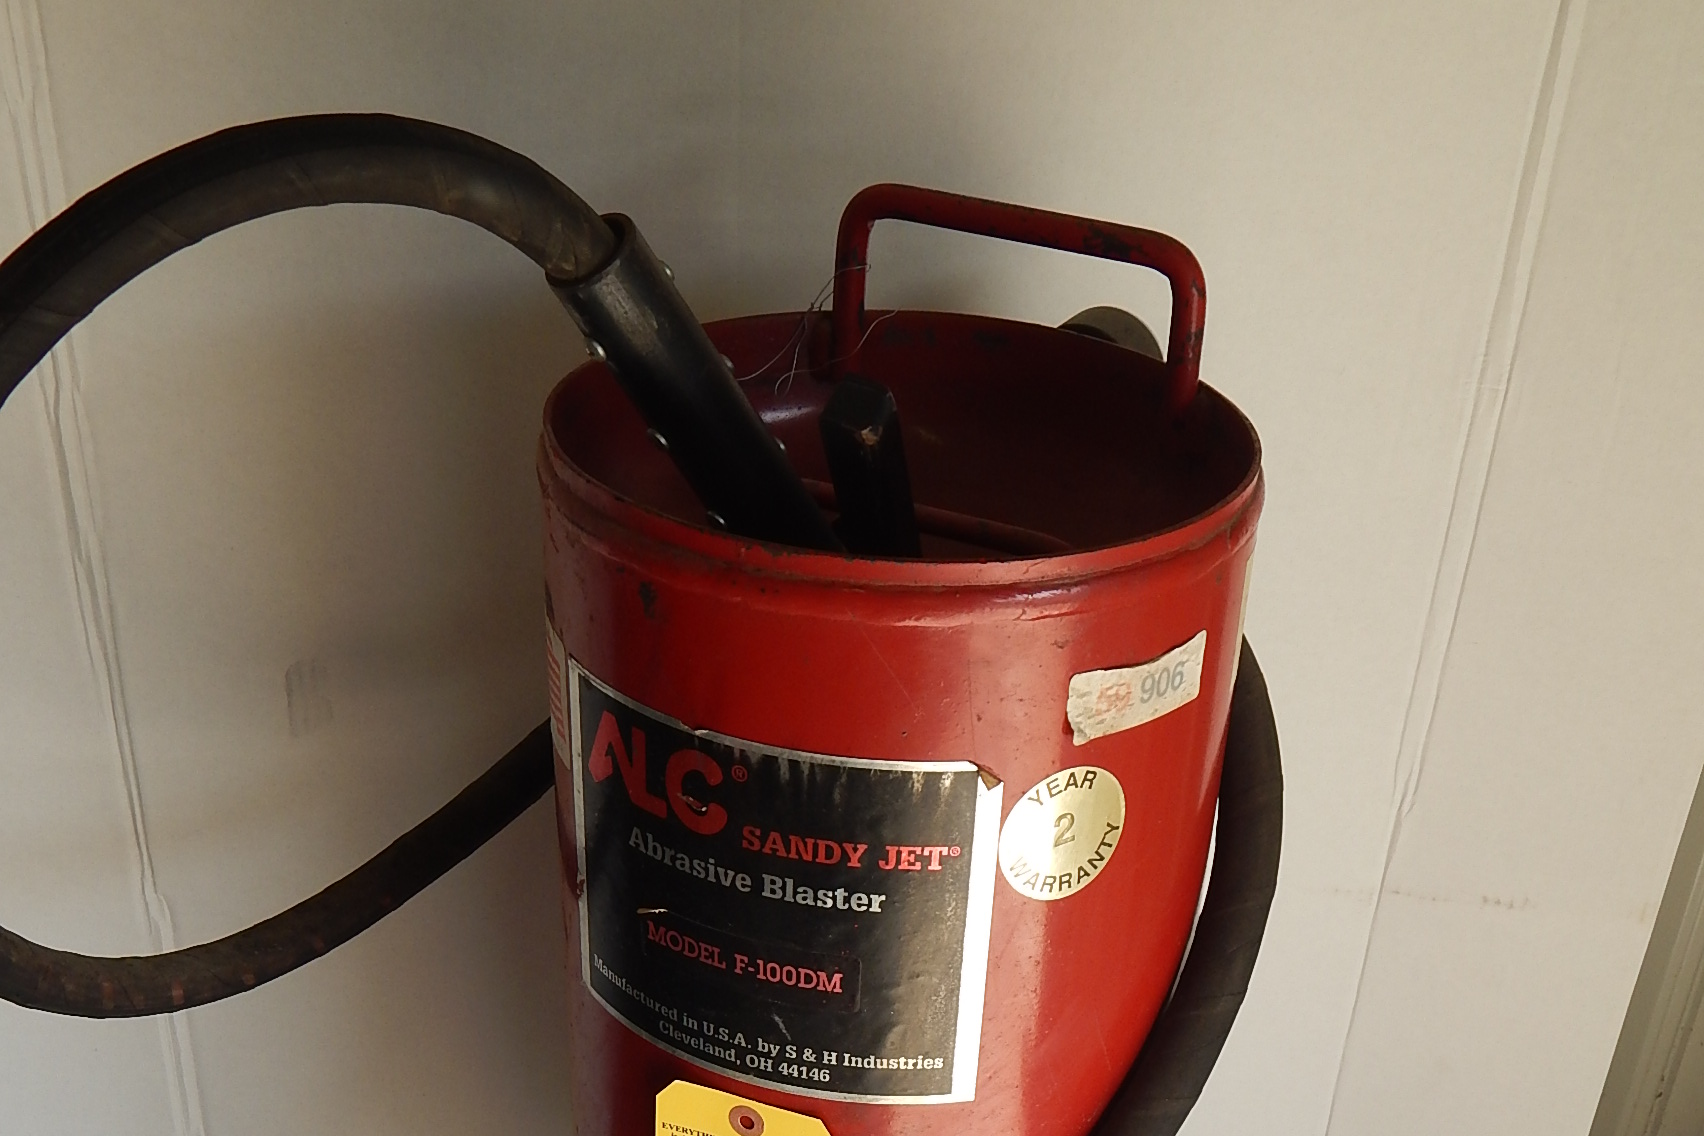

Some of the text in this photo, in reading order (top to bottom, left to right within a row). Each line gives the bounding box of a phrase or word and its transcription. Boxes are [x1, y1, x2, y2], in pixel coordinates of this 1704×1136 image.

[1140, 660, 1187, 704] 906
[1027, 769, 1098, 806] YEAR
[742, 826, 868, 869] SANDY
[1009, 821, 1120, 893] WARRANTY
[1053, 812, 1076, 848] 2
[628, 827, 886, 913] Abrasive Blaster
[647, 920, 843, 994] MODEL F-100DM
[594, 953, 944, 1070] Manufactured in U.S.A. by S & H Industries
[659, 1020, 831, 1083] Cleveland, OH 44146
